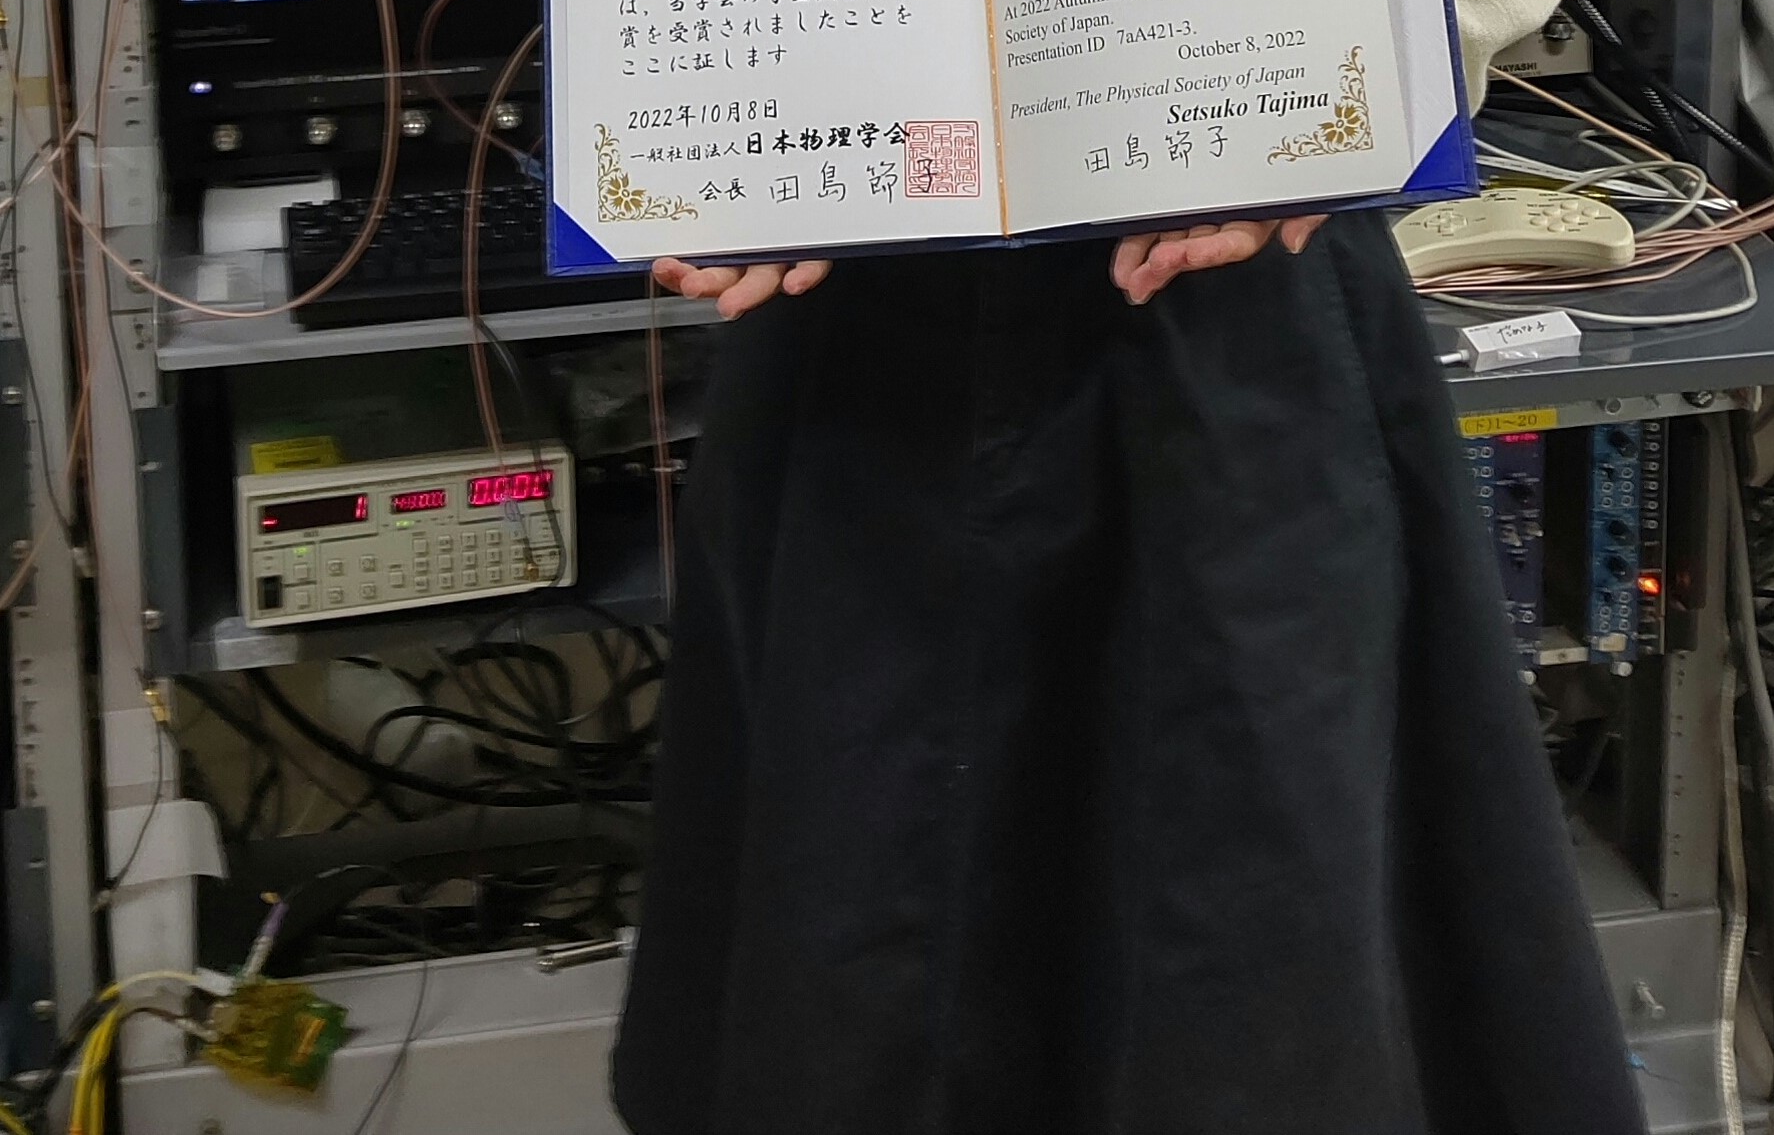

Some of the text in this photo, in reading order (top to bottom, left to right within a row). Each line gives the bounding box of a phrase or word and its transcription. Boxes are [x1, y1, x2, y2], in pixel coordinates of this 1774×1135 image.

[619, 4, 911, 48] 賞を受賞されましたことを
[1004, 6, 1017, 20] At
[1005, 14, 1113, 44] Society of Japan.
[1007, 20, 1196, 67] Presentation ID 7aA421-3.
[1177, 29, 1305, 59] October 8, 2022
[622, 43, 787, 75] ここに証します
[1010, 66, 1304, 119] President, The Physical Society of Japan
[1166, 90, 1328, 124] Setsuko Tajima
[627, 98, 777, 129] 2022年10月8日
[699, 178, 746, 200] 会長
